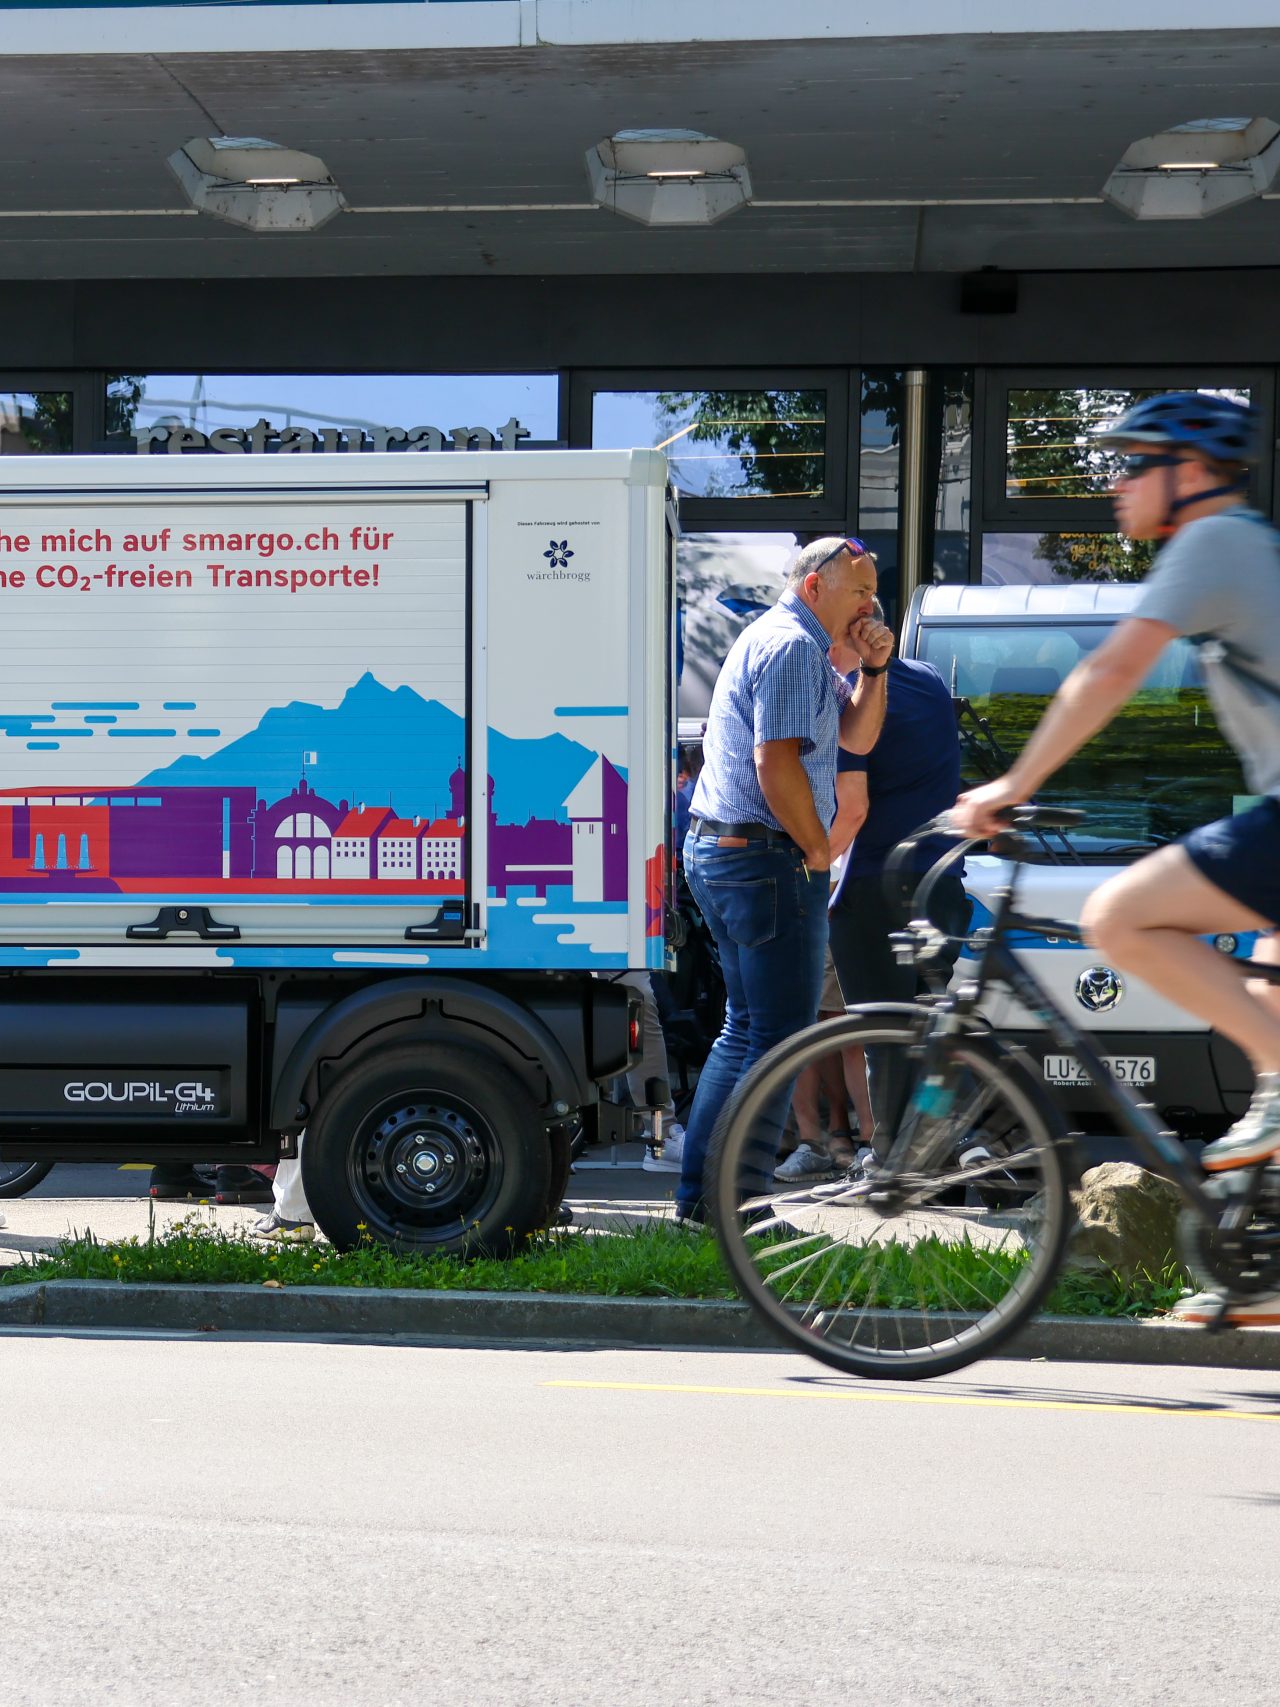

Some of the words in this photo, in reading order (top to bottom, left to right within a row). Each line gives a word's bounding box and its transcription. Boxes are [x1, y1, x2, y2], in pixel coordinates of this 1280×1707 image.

[41, 528, 112, 552] mich
[123, 528, 171, 552] auf
[182, 527, 339, 557] smargo.ch
[350, 526, 394, 550] für
[207, 564, 379, 593] Transporte!
[527, 570, 591, 582] wärchbrogg
[174, 1102, 215, 1113] Lithium
